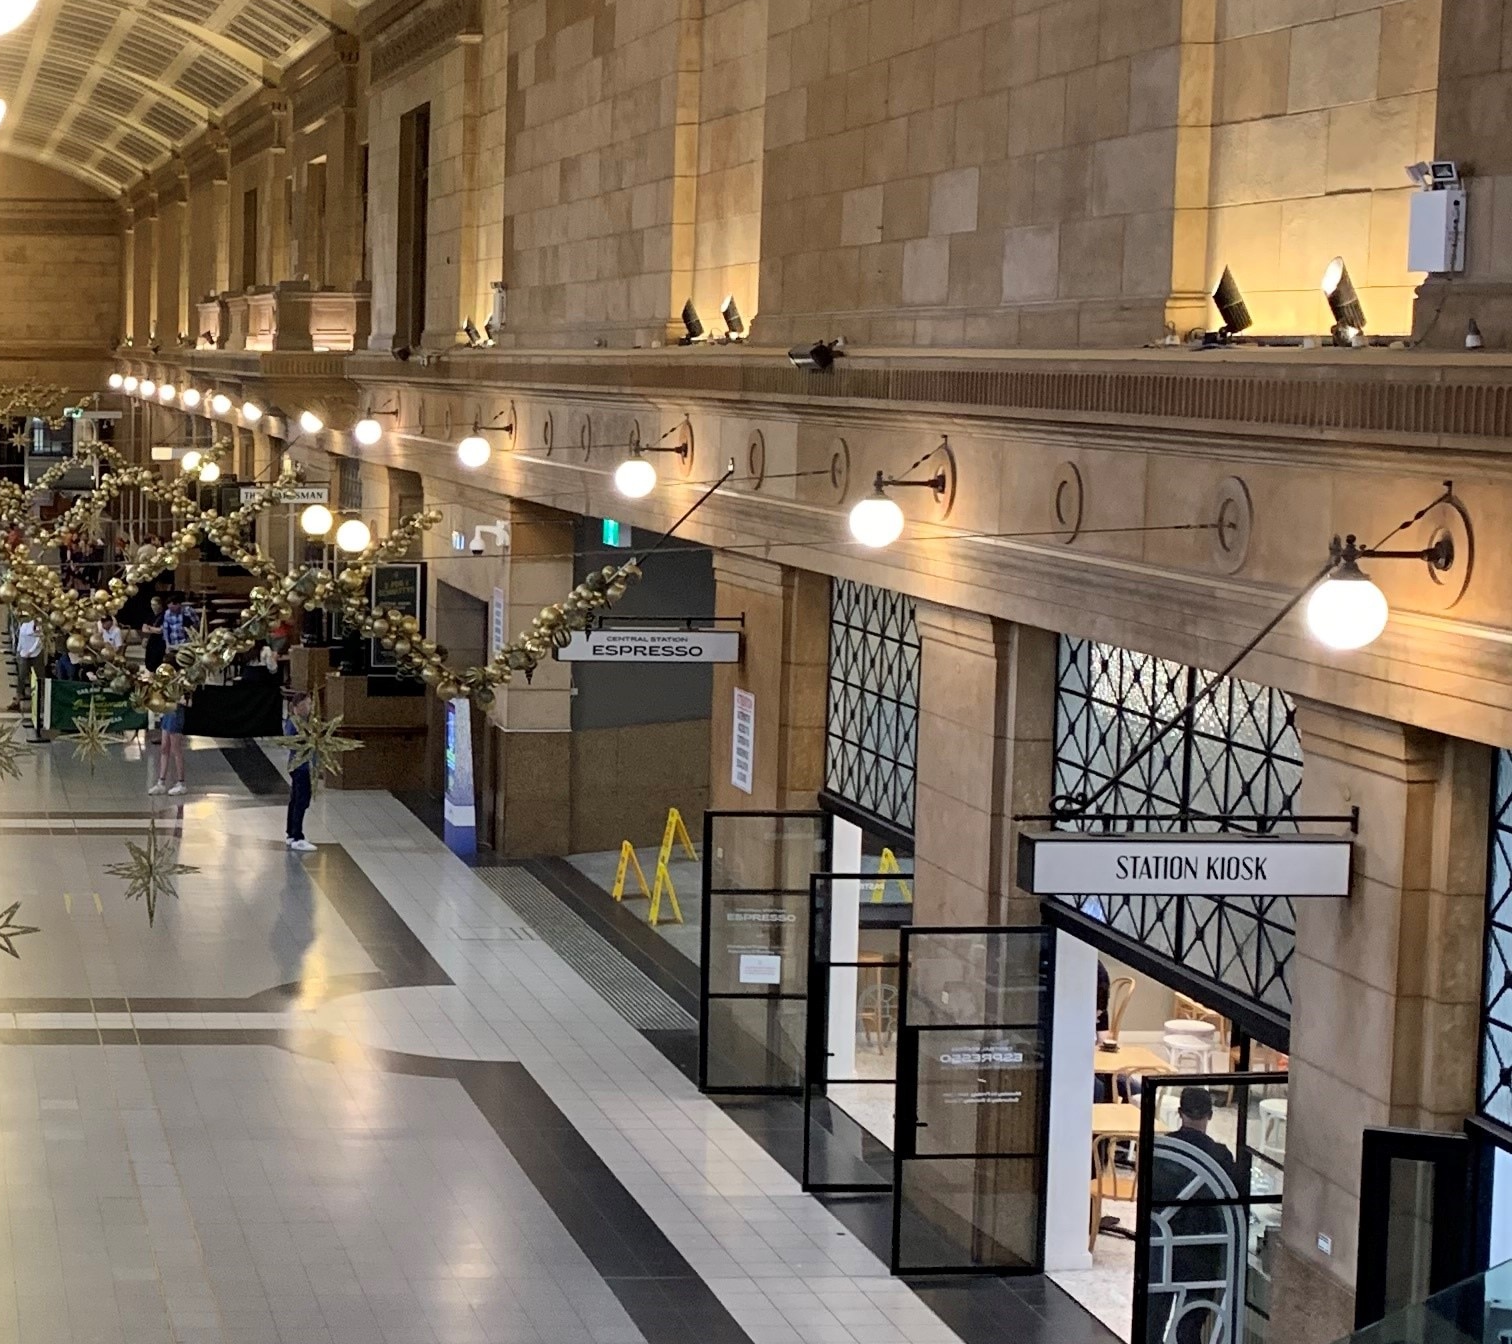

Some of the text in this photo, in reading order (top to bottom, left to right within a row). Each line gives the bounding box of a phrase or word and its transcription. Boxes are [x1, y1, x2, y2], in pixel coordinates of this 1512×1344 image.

[592, 645, 703, 657] ESPRESSO
[1116, 855, 1268, 881] STATION KIOSK
[726, 913, 797, 922] ESPRESSO
